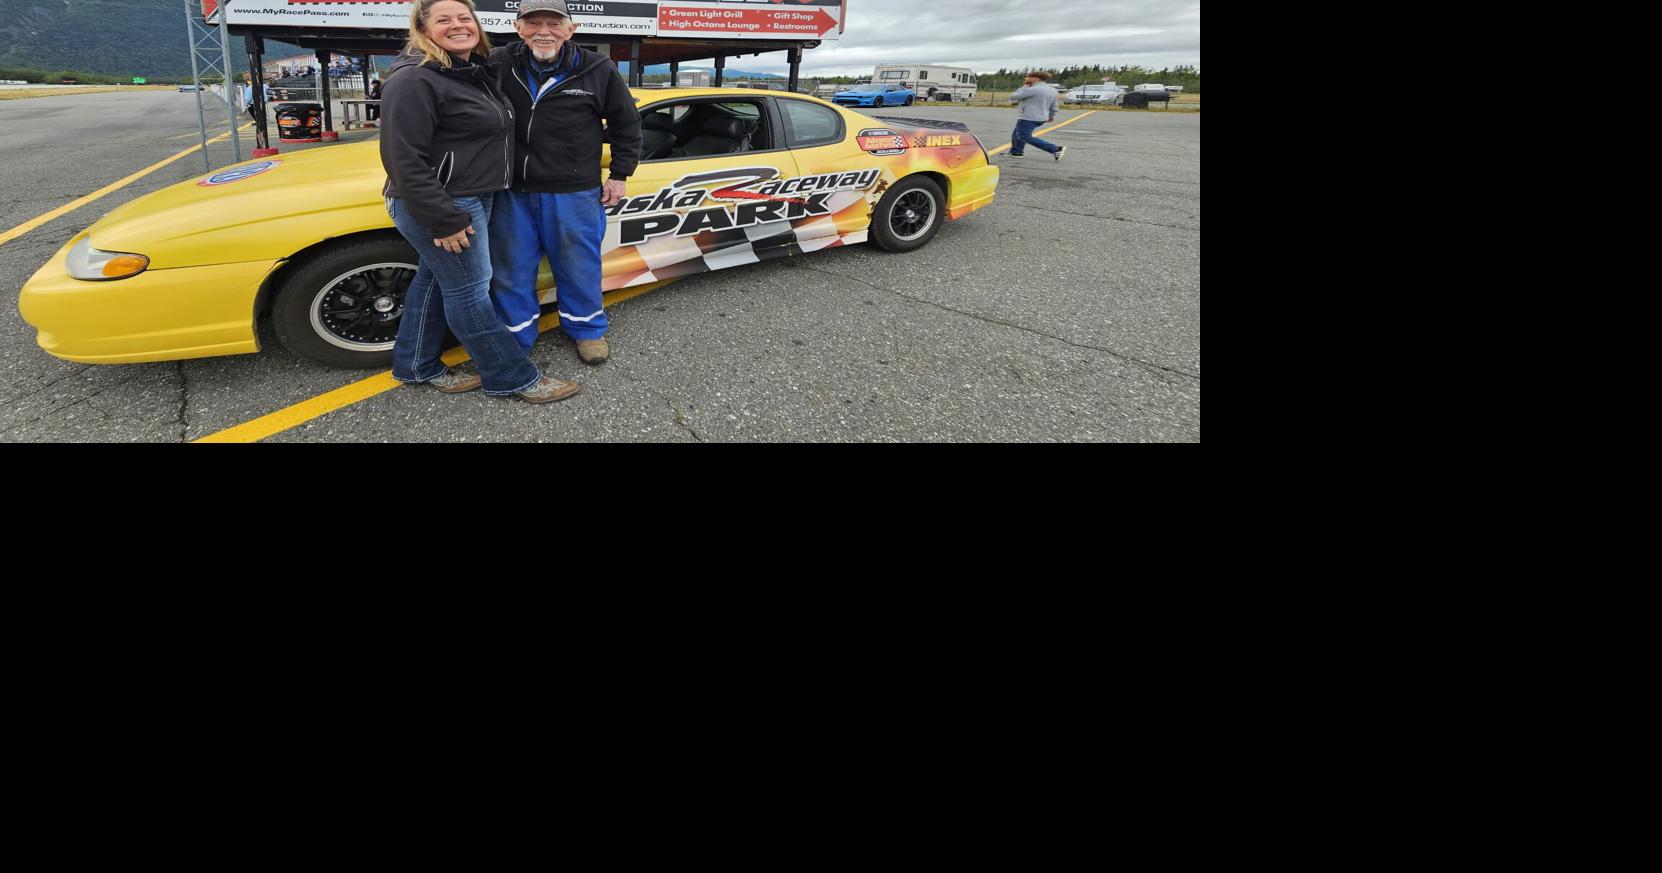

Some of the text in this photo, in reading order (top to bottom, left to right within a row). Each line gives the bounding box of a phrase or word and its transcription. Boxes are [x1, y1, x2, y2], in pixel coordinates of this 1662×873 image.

[233, 8, 350, 17] www.MyRacePass.com
[669, 9, 698, 17] Green
[700, 10, 722, 18] Light
[773, 12, 814, 21] Gift Shop
[480, 17, 514, 26] 357.4
[668, 20, 691, 28] High
[727, 22, 760, 30] Lounge
[773, 23, 818, 31] Restrooms
[926, 135, 961, 147] INEX
[620, 192, 832, 245] PARK
